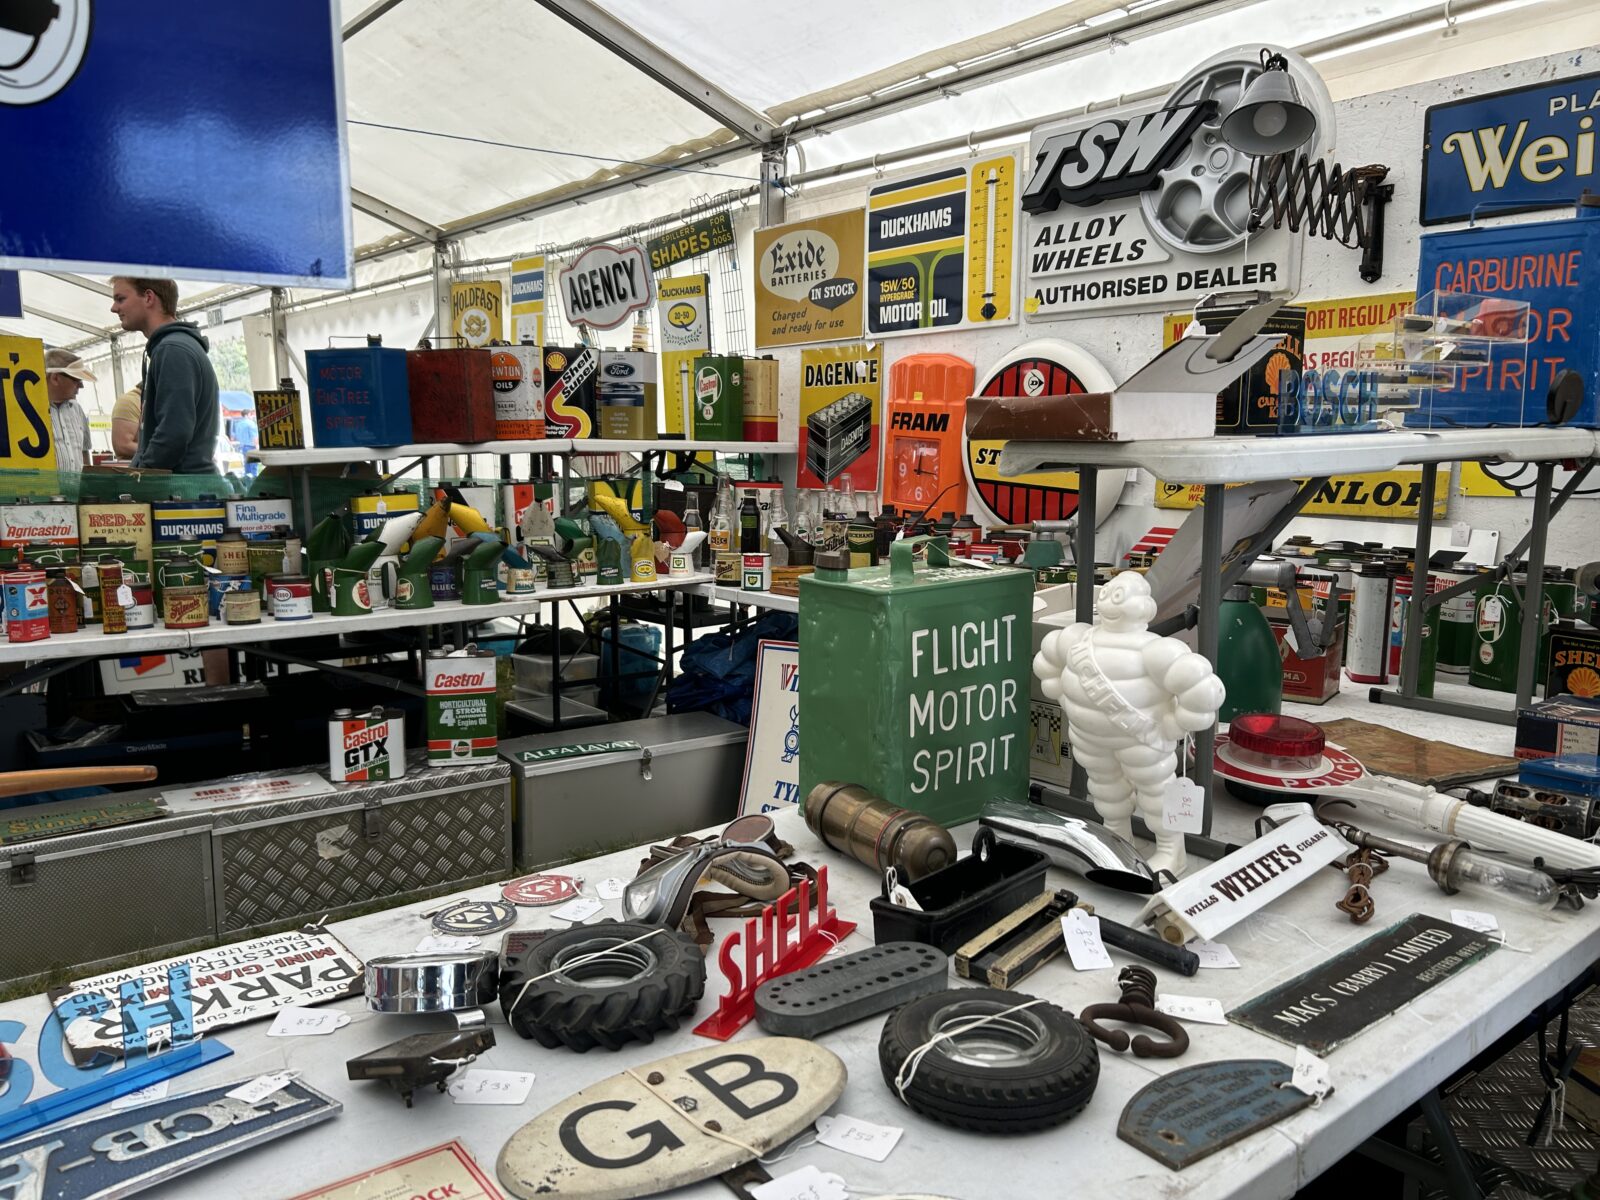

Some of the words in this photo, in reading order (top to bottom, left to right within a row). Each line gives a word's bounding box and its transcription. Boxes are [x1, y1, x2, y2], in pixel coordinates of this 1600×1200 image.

[1022, 100, 1206, 204] TSW
[1442, 115, 1596, 193] Wei
[710, 215, 725, 227] FOR
[712, 226, 727, 236] ALL
[880, 207, 952, 239] DUCKHAMS
[1034, 213, 1127, 247] ALLOY
[651, 231, 711, 268] SHAPES
[713, 233, 732, 245] DOGS
[770, 237, 825, 274] Exide
[1032, 239, 1147, 273] WHEELS
[771, 270, 827, 287] BATTERIES
[880, 276, 915, 292] 15W/50
[1034, 273, 1168, 306] AUTHORISED
[1176, 261, 1277, 292] DEALER
[1436, 251, 1581, 297] CARBURINE
[512, 280, 543, 295] DUCKHAMS
[569, 257, 638, 316] AGENCY
[661, 285, 701, 297] DUCKHAMS
[811, 287, 822, 299] IN
[823, 281, 855, 298] STOCK
[453, 287, 499, 318] HOLDFAST
[879, 302, 923, 324] MOTOR
[929, 299, 948, 317] OIL
[772, 308, 808, 322] Charged
[1306, 310, 1336, 330] ORT
[1338, 301, 1416, 328] REGULATI
[772, 323, 786, 335] and
[789, 321, 812, 333] ready
[814, 319, 827, 331] for
[829, 319, 844, 328] use
[492, 365, 520, 377] EWTON
[562, 349, 592, 385] Shell
[611, 364, 629, 375] Ford
[496, 381, 513, 389] OILS
[562, 361, 594, 398] Super
[1279, 369, 1378, 424] BOSCH
[891, 412, 950, 432] FRAM
[975, 448, 1000, 466] ST
[235, 504, 256, 513] Fina
[236, 512, 286, 523] Multigrade
[7, 525, 72, 538] Agricastrol
[160, 523, 224, 536] DUCKHAMS
[431, 583, 456, 591] BLUEC
[912, 614, 1017, 678] FLIGHT
[434, 672, 485, 688] Castrol
[439, 699, 487, 709] HORTICULTURAL
[909, 679, 1017, 738] MOTOR
[439, 709, 455, 726] 4
[458, 719, 477, 727] Engine
[343, 722, 389, 750] Castrol
[344, 736, 389, 768] GTX
[910, 733, 1015, 794] SPIRIT
[1281, 757, 1360, 787] POLICE
[1185, 894, 1219, 917] WILLS
[1211, 843, 1303, 902] WHIFFS
[1296, 830, 1328, 852] CIGARS
[245, 932, 303, 951] PARKER
[719, 865, 837, 1012] SHELL
[211, 944, 242, 957] LTD.
[138, 954, 206, 976] VIADUCT
[181, 946, 336, 992] MINI-GIANT
[1273, 992, 1338, 1027] MAC'S
[1329, 961, 1396, 996] (BARRY)
[1384, 928, 1453, 964] LIMITED
[75, 985, 170, 1017] MIXER
[88, 957, 357, 1041] PARKER
[299, 980, 349, 1001] ODEL
[109, 1028, 164, 1048] CAPAC
